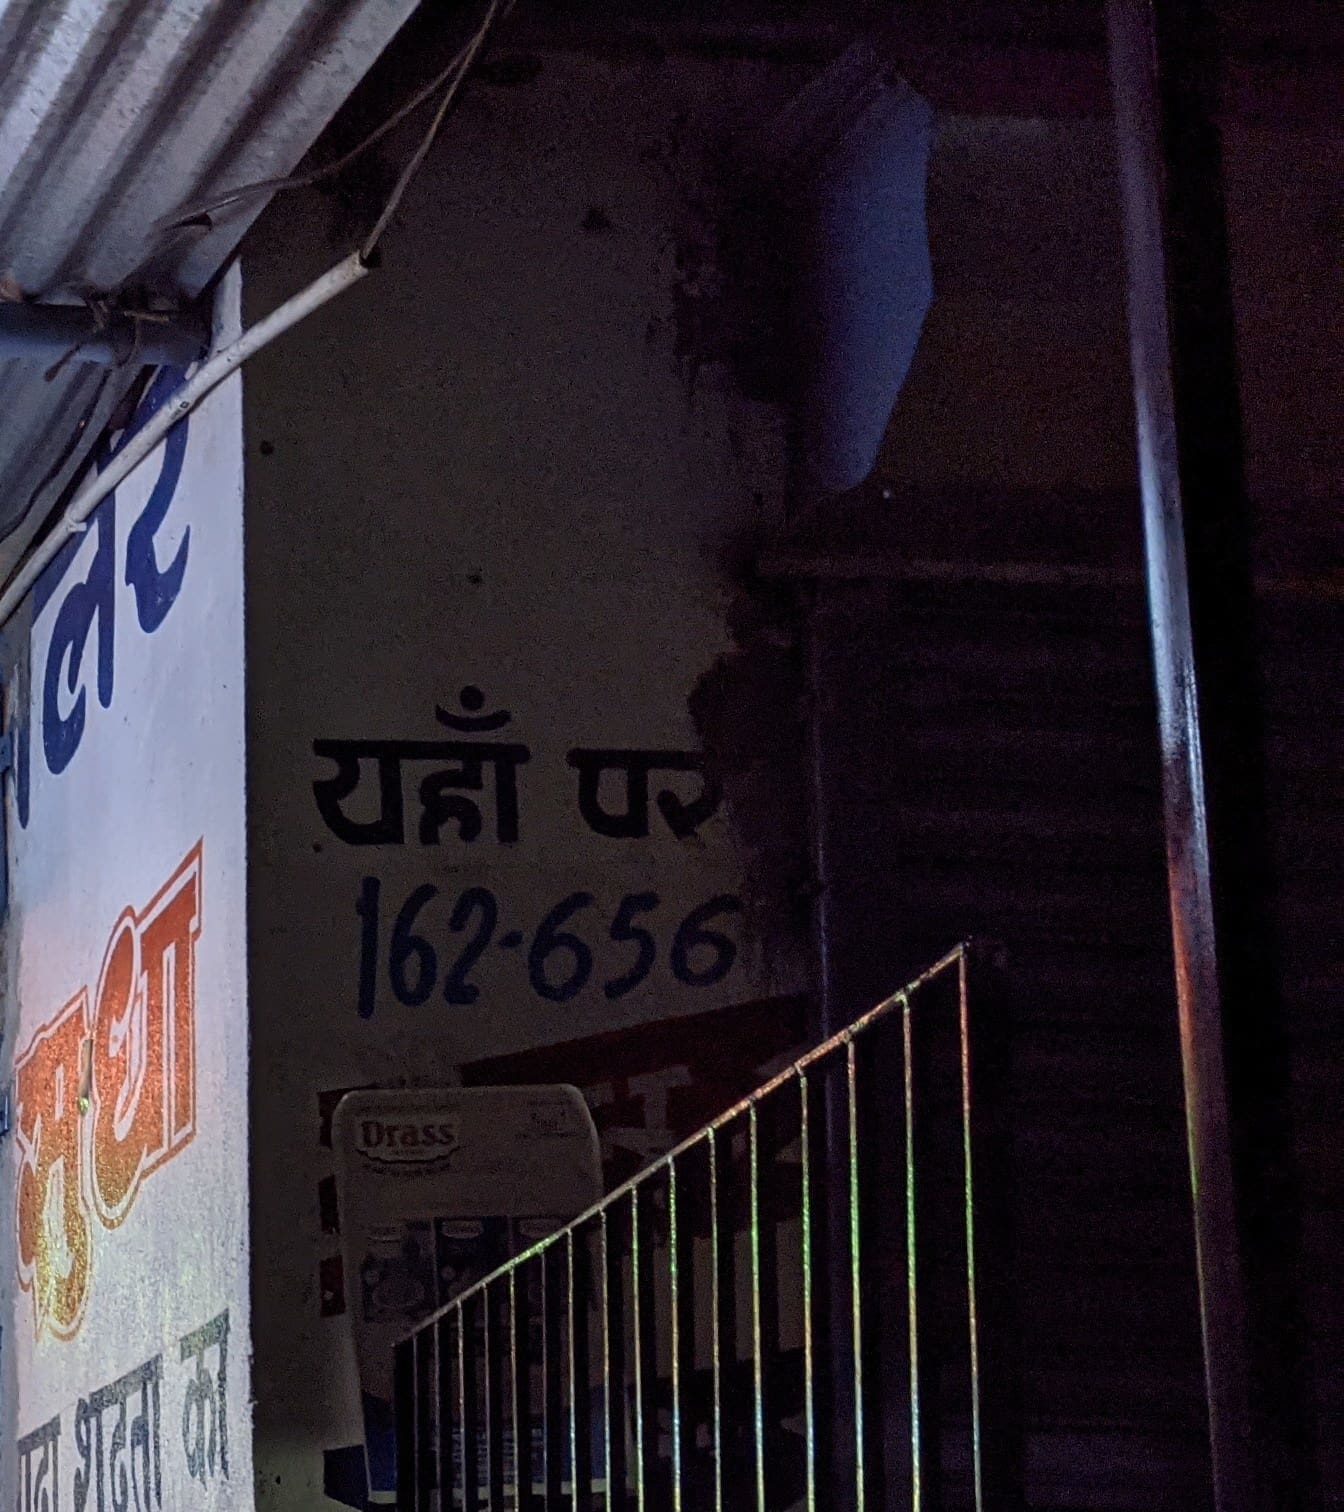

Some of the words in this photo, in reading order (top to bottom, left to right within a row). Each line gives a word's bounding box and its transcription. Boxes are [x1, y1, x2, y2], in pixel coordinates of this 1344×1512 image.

[313, 684, 530, 846] यहाँ
[566, 748, 723, 840] पर
[355, 876, 744, 1020] 162-656
